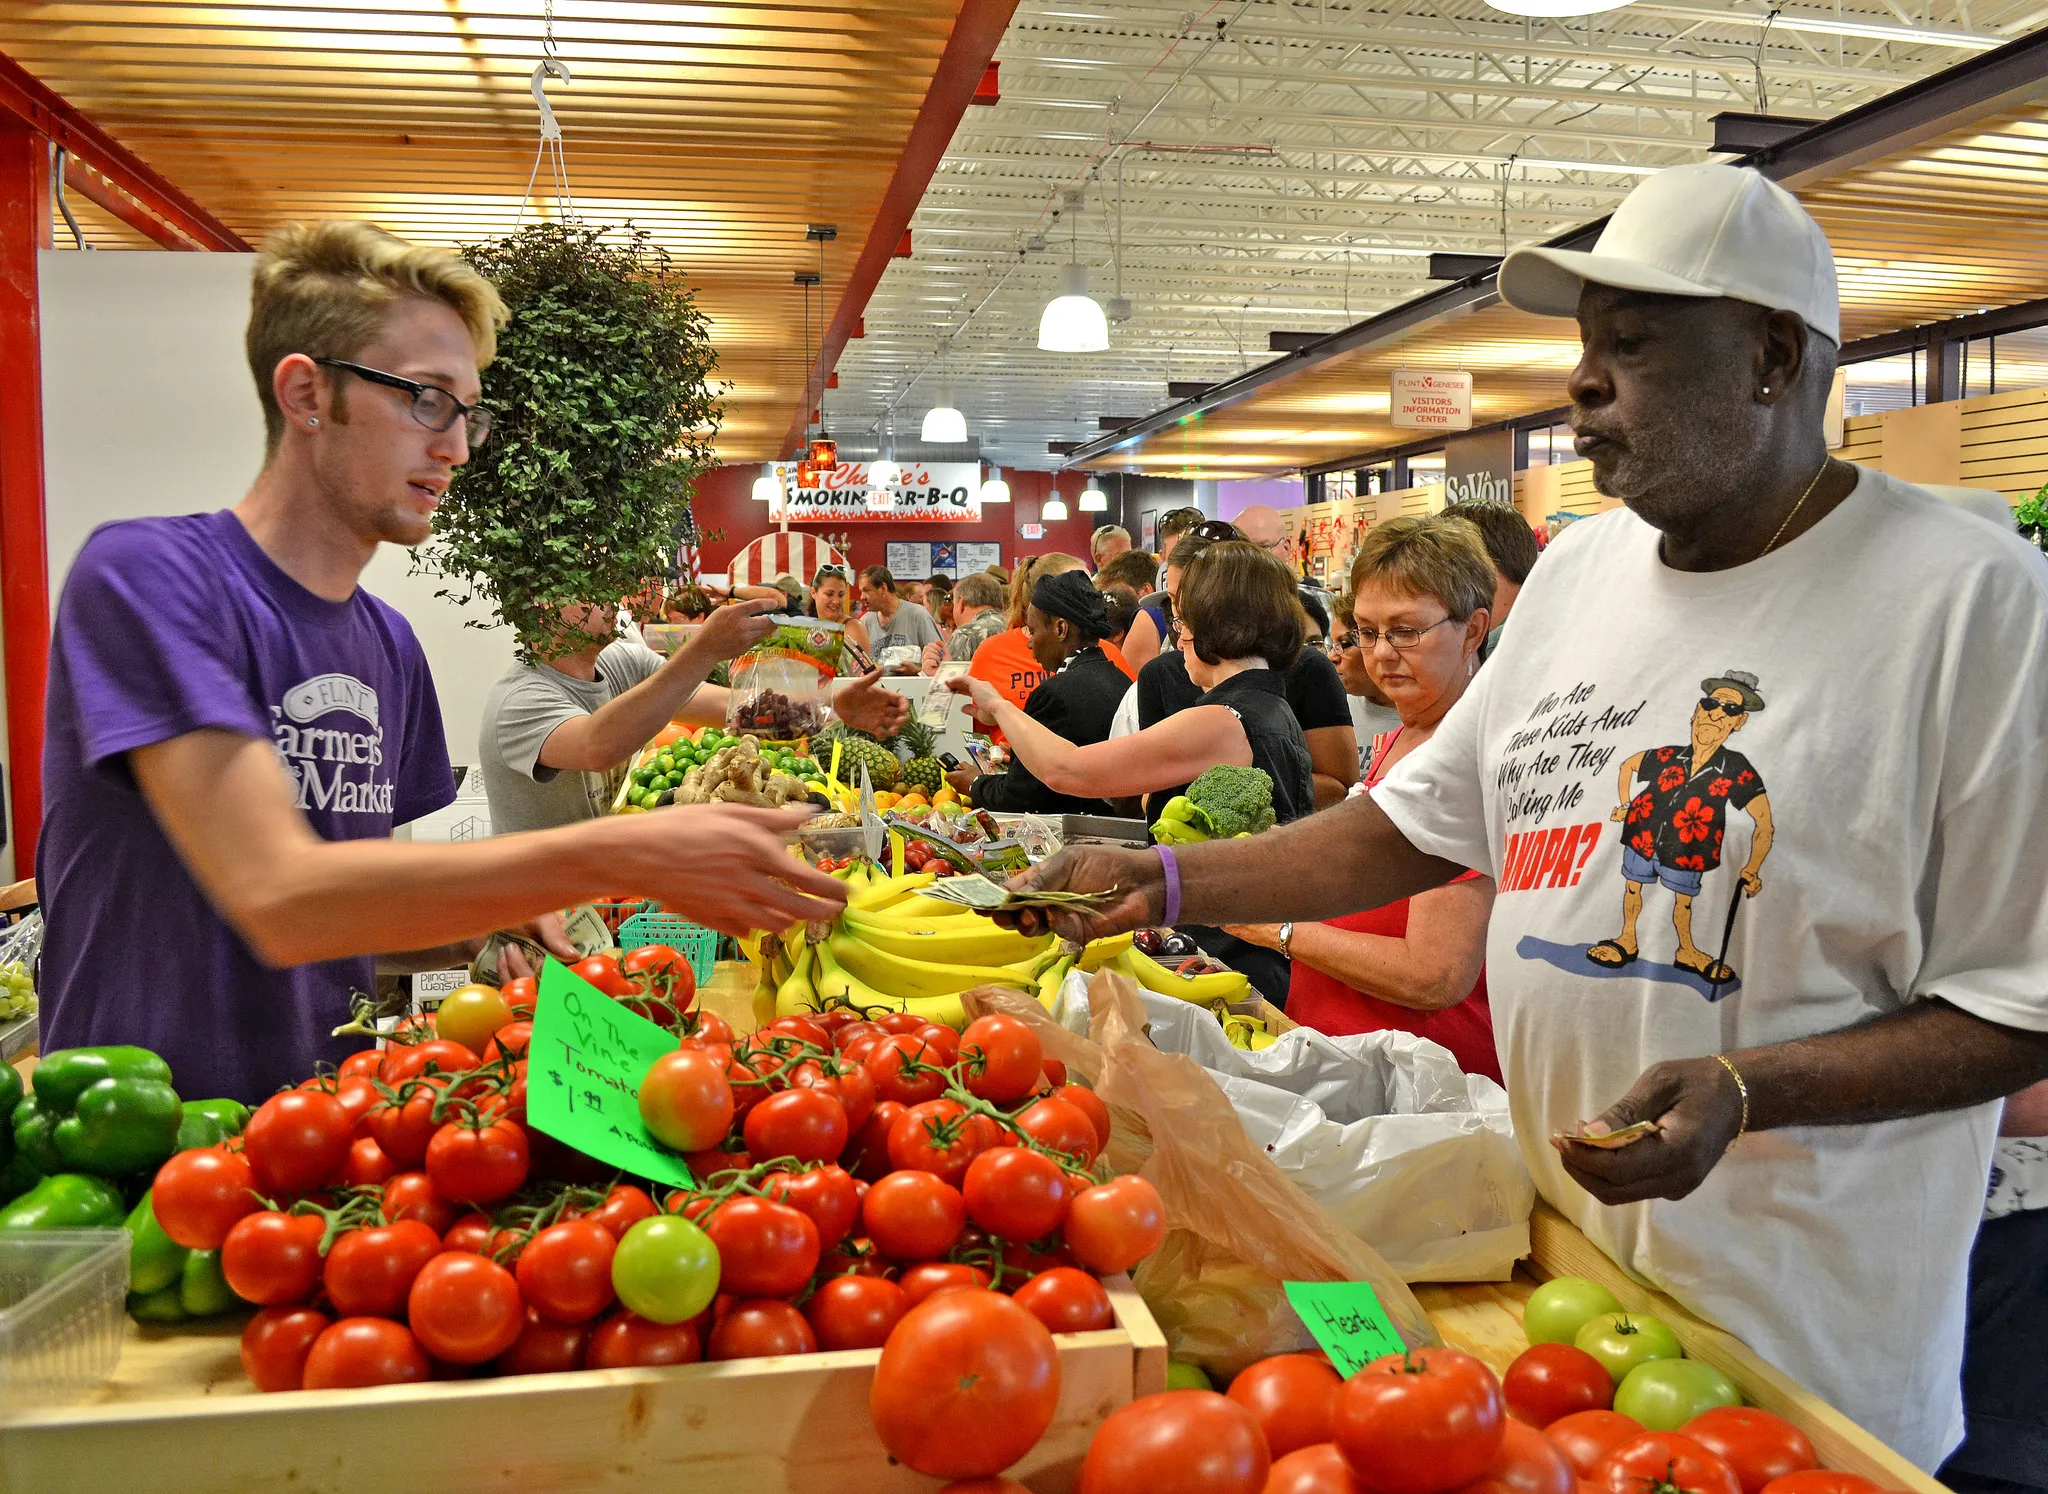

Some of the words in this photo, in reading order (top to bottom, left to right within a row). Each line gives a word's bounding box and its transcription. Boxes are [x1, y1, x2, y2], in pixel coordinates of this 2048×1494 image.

[1398, 379, 1420, 387] FLINT
[1433, 380, 1465, 389] GENESEE
[1402, 405, 1461, 415] INFORMATION
[1411, 397, 1452, 406] VISITORS
[1415, 415, 1448, 423] CENTER
[872, 492, 891, 505] EXIT
[889, 486, 968, 508] AR-B-Q
[1026, 524, 1040, 535] EXIT
[318, 681, 368, 711] FLINT
[1526, 691, 1560, 723] Who
[1561, 681, 1596, 709] Are
[1503, 726, 1542, 756] These
[1541, 710, 1589, 743] Kids
[1590, 700, 1647, 733] And
[1497, 757, 1526, 793] Why
[1527, 750, 1560, 777] Are
[1566, 740, 1617, 777] They
[295, 760, 394, 813] Market
[1552, 781, 1584, 813] Me
[1497, 822, 1603, 895] ANDPA?
[420, 973, 446, 983] build
[563, 992, 592, 1028] On
[601, 1016, 640, 1061] The
[572, 1021, 631, 1073] Vine
